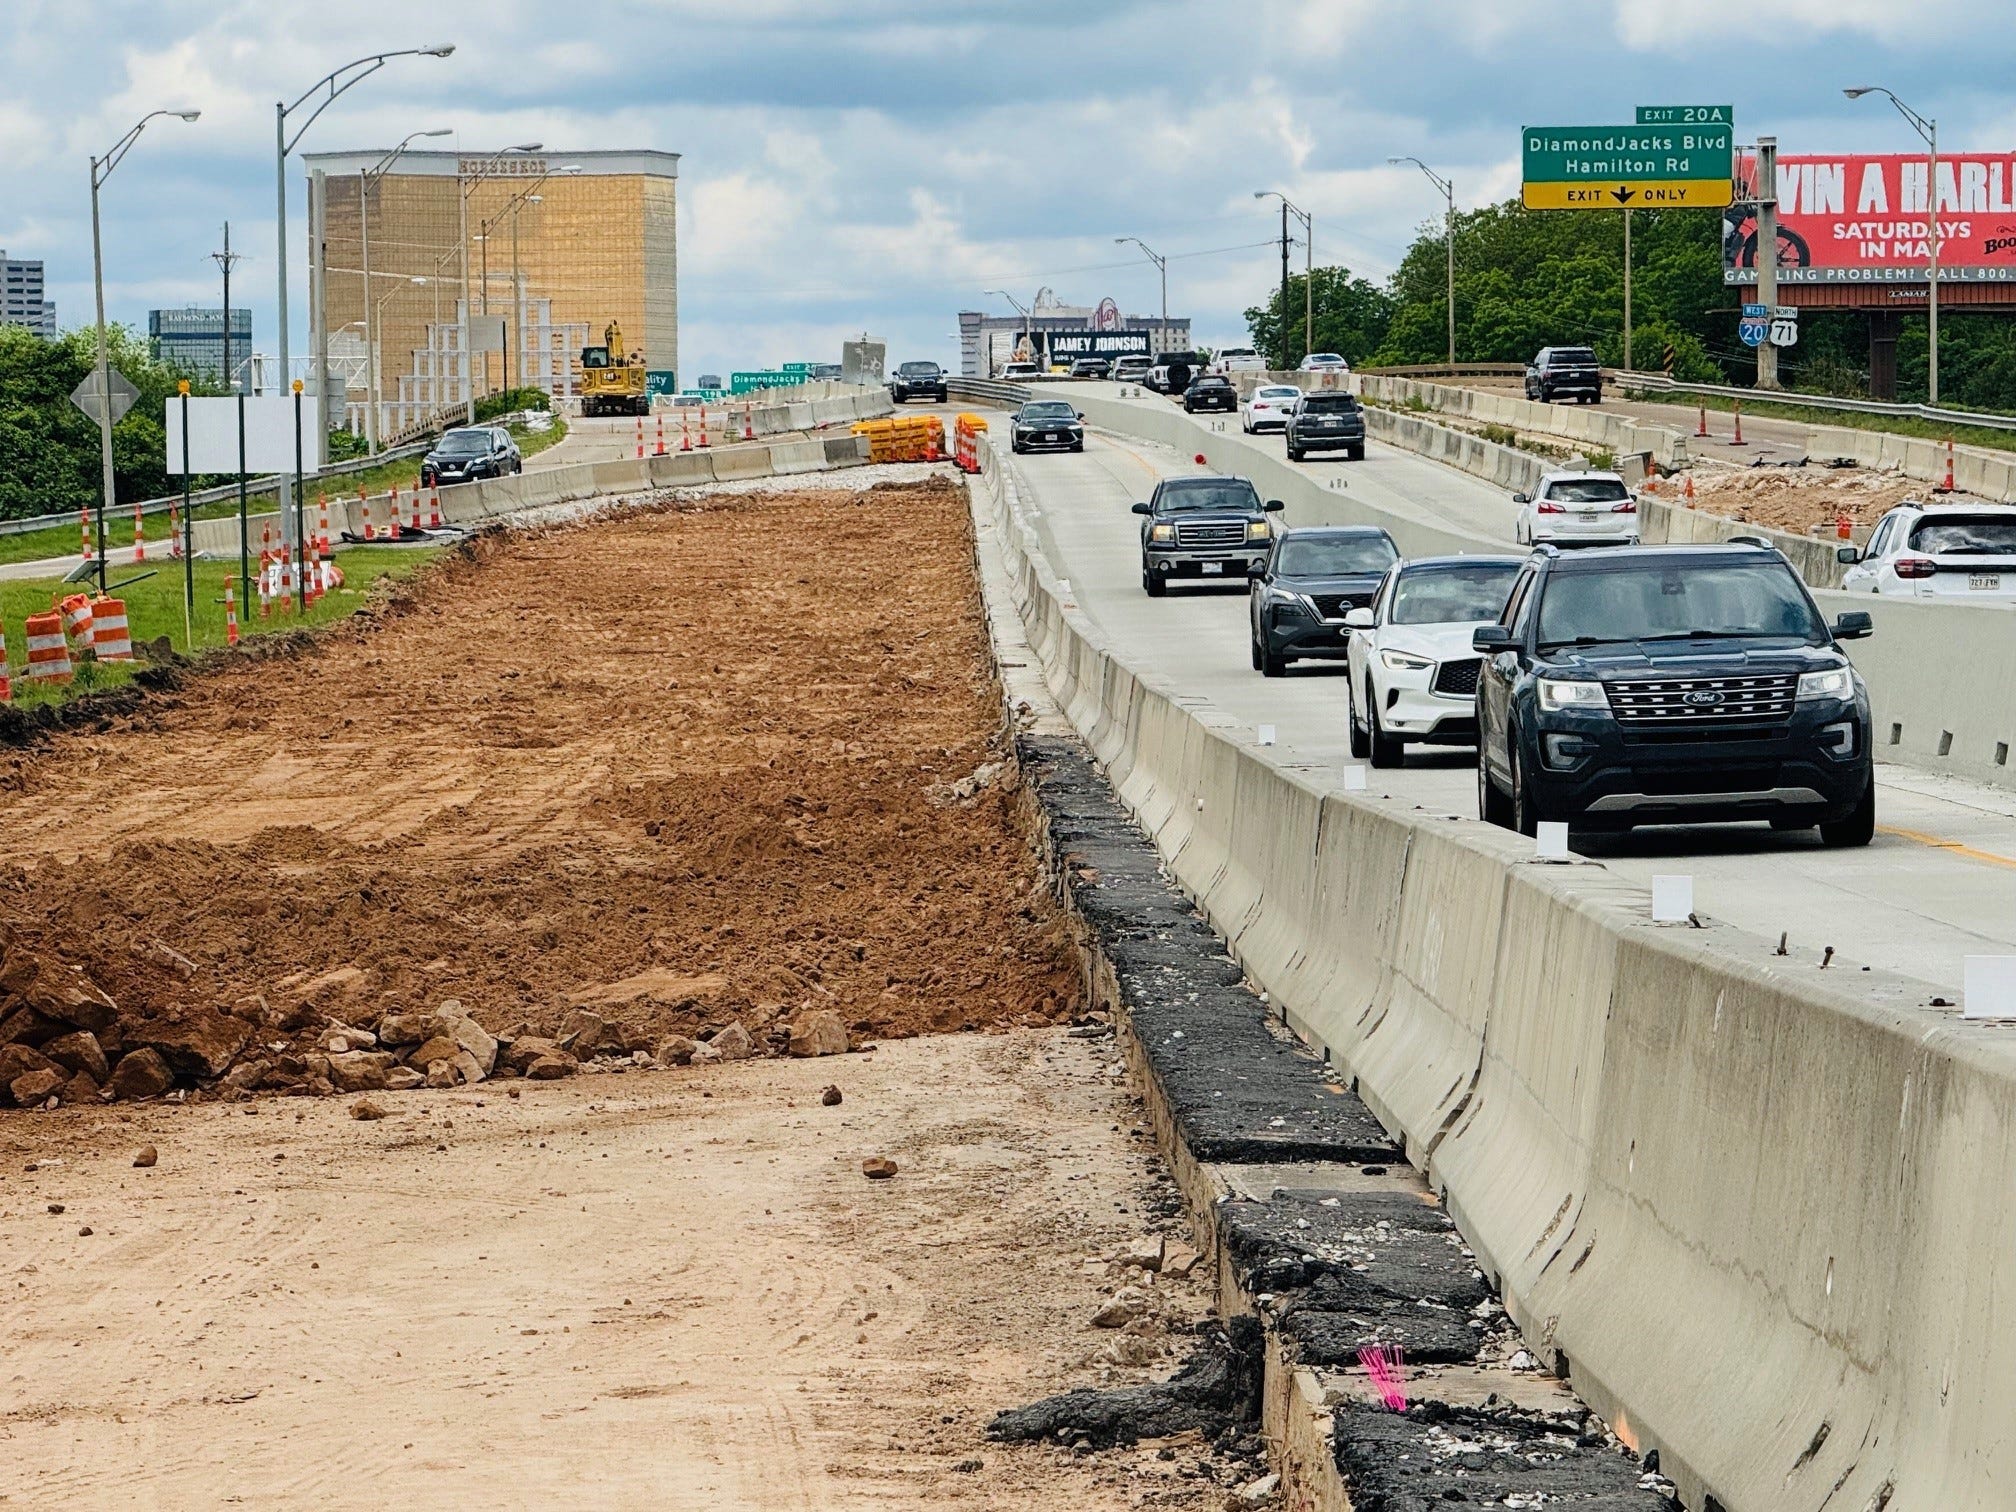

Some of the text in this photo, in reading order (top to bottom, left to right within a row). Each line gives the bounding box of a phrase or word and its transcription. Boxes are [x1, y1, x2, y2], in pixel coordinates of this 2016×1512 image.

[1645, 108, 1723, 122] EXIT 20A
[1530, 135, 1725, 152] DiamondJacks Blvd
[1566, 157, 1689, 174] Hamilton Rd
[1567, 189, 1687, 201] EXIT ONLY
[1857, 162, 1889, 214] A
[1901, 162, 2016, 213] HARL
[1833, 221, 1971, 239] SATURDAYS
[1860, 241, 1945, 258] IN MAY
[1724, 269, 1817, 282] GAMLING
[1827, 268, 1914, 280] PROBLEM?
[1924, 268, 1969, 279] CALL
[1746, 306, 1765, 315] WEST
[1776, 307, 1797, 316] NORTH
[1744, 324, 1763, 341] 20
[1775, 325, 1792, 341] 71
[1053, 336, 1147, 352] JAMEY JOHNSON
[734, 375, 800, 383] DiamondJacks
[1692, 692, 1715, 702] Ford
